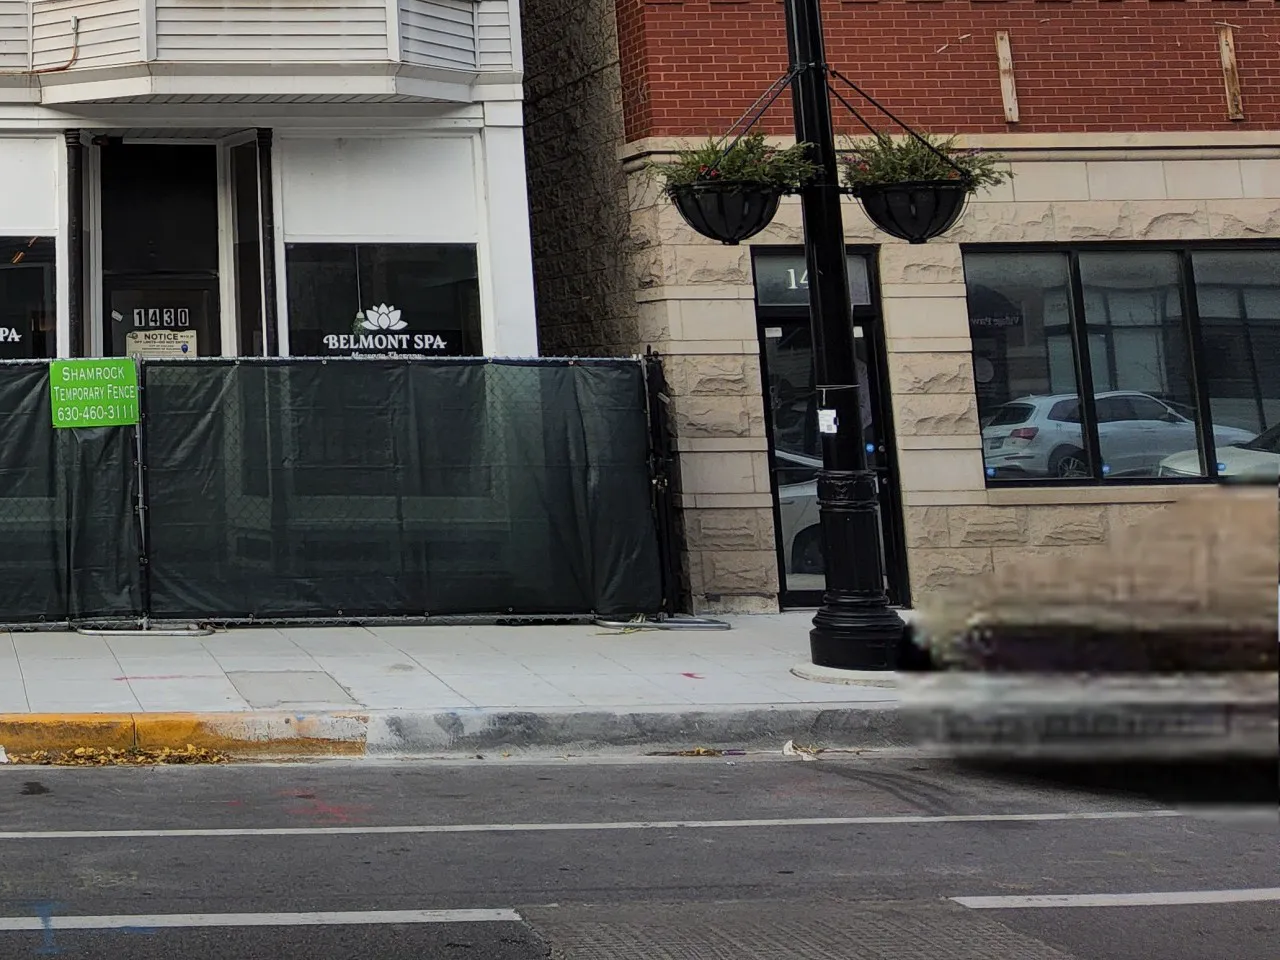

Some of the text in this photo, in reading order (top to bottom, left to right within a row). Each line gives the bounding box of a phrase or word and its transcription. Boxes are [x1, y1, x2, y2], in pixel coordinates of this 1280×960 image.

[134, 308, 189, 327] 1430
[144, 332, 179, 341] NOTICE
[322, 334, 448, 349] BELMONT SPA
[62, 366, 125, 381] SHAMROCK
[53, 384, 136, 402] TEMPORARY FENCE
[57, 403, 135, 421] 630-460-3111
